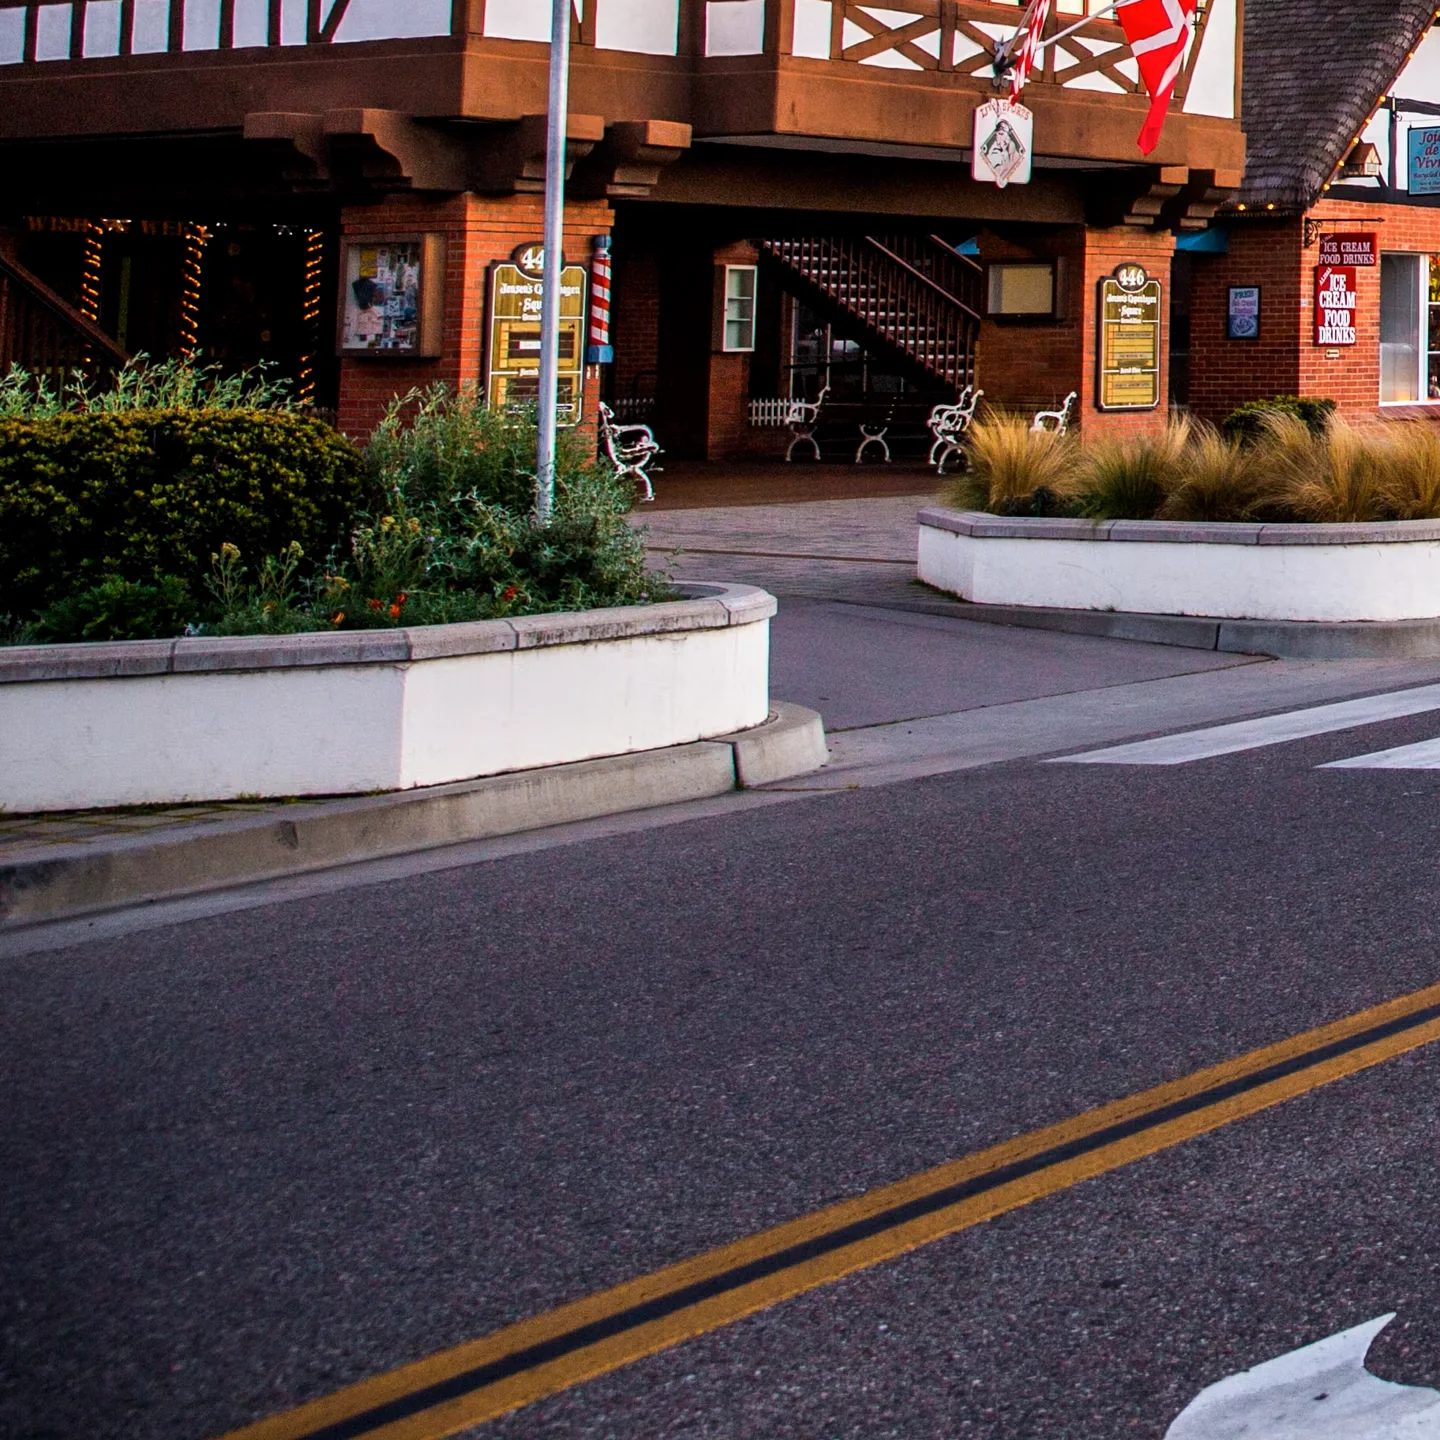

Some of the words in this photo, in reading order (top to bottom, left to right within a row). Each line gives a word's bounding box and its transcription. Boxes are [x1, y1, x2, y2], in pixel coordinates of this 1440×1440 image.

[1425, 144, 1439, 156] de
[1323, 242, 1338, 252] ICE
[1340, 242, 1371, 252] CREAM
[521, 248, 545, 270] 44
[1319, 254, 1341, 264] FOOD
[1343, 254, 1375, 264] DRINKS
[1119, 269, 1145, 286] 446
[1329, 274, 1346, 292] ICE
[1319, 291, 1356, 309] CREAM
[1324, 309, 1350, 327] FOOD
[1318, 326, 1356, 344] DRINKS
